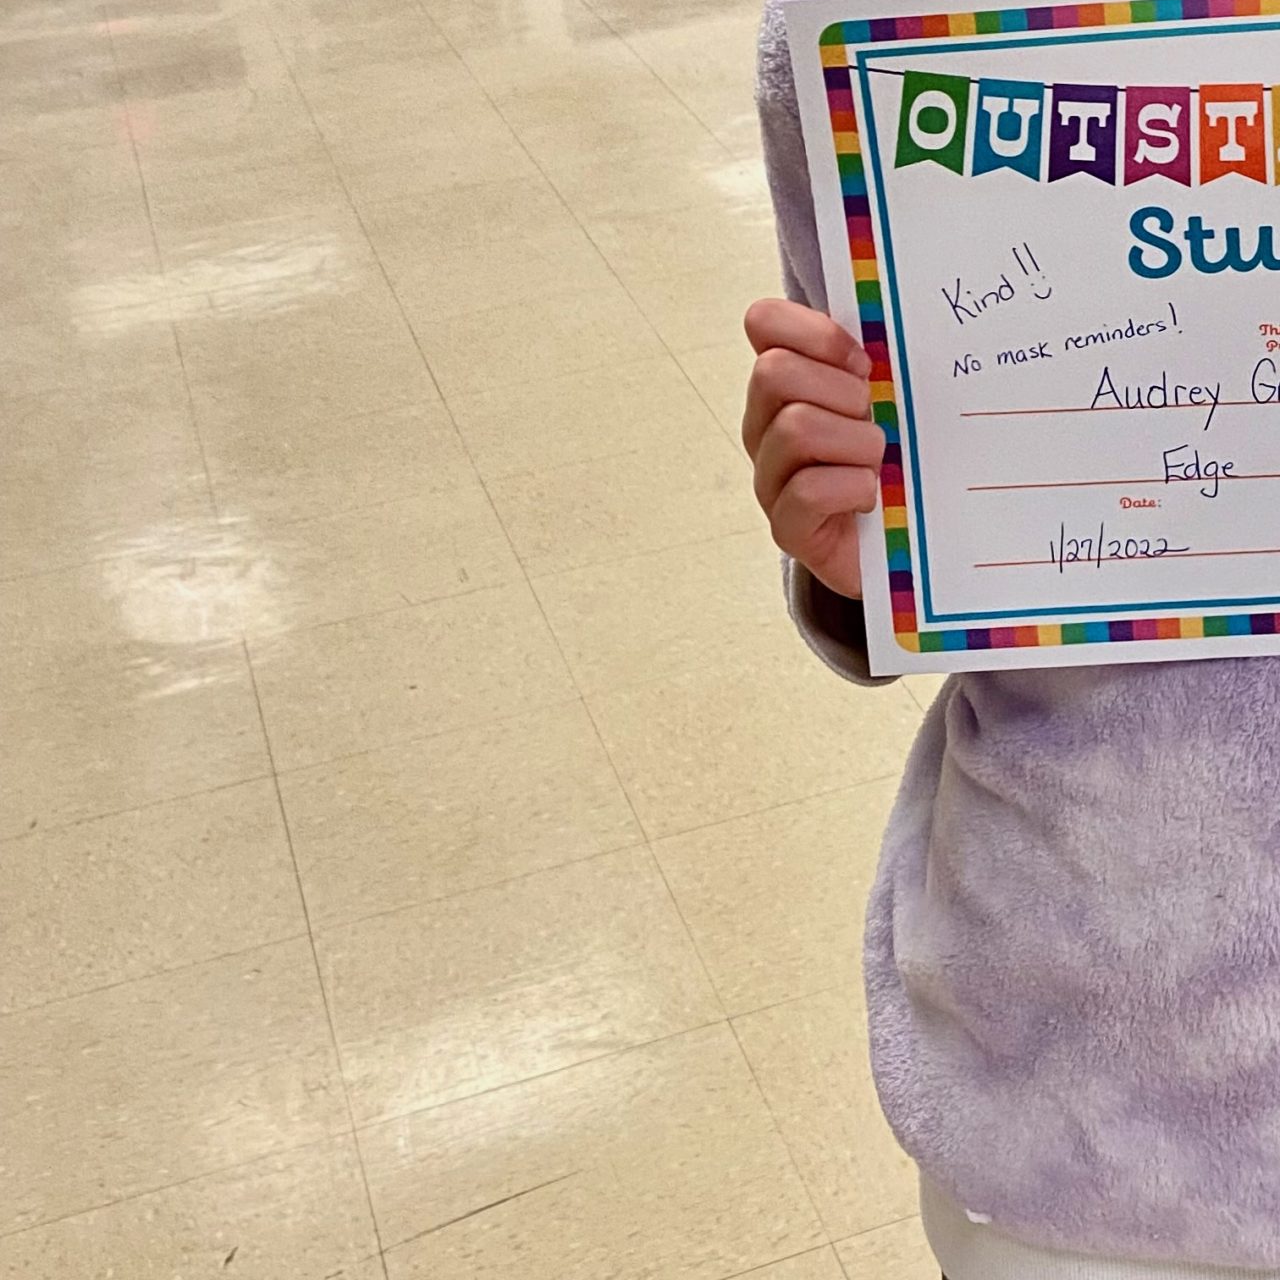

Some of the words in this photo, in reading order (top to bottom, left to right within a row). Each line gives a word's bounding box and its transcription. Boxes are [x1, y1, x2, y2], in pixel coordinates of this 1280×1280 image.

[953, 353, 982, 377] No
[996, 341, 1053, 366] mask
[1064, 302, 1182, 350] reminders!
[1090, 366, 1220, 431] Audrey
[1163, 444, 1239, 497] Edge
[1119, 496, 1162, 509] Date:
[1050, 521, 1190, 573] 1/27/2022
